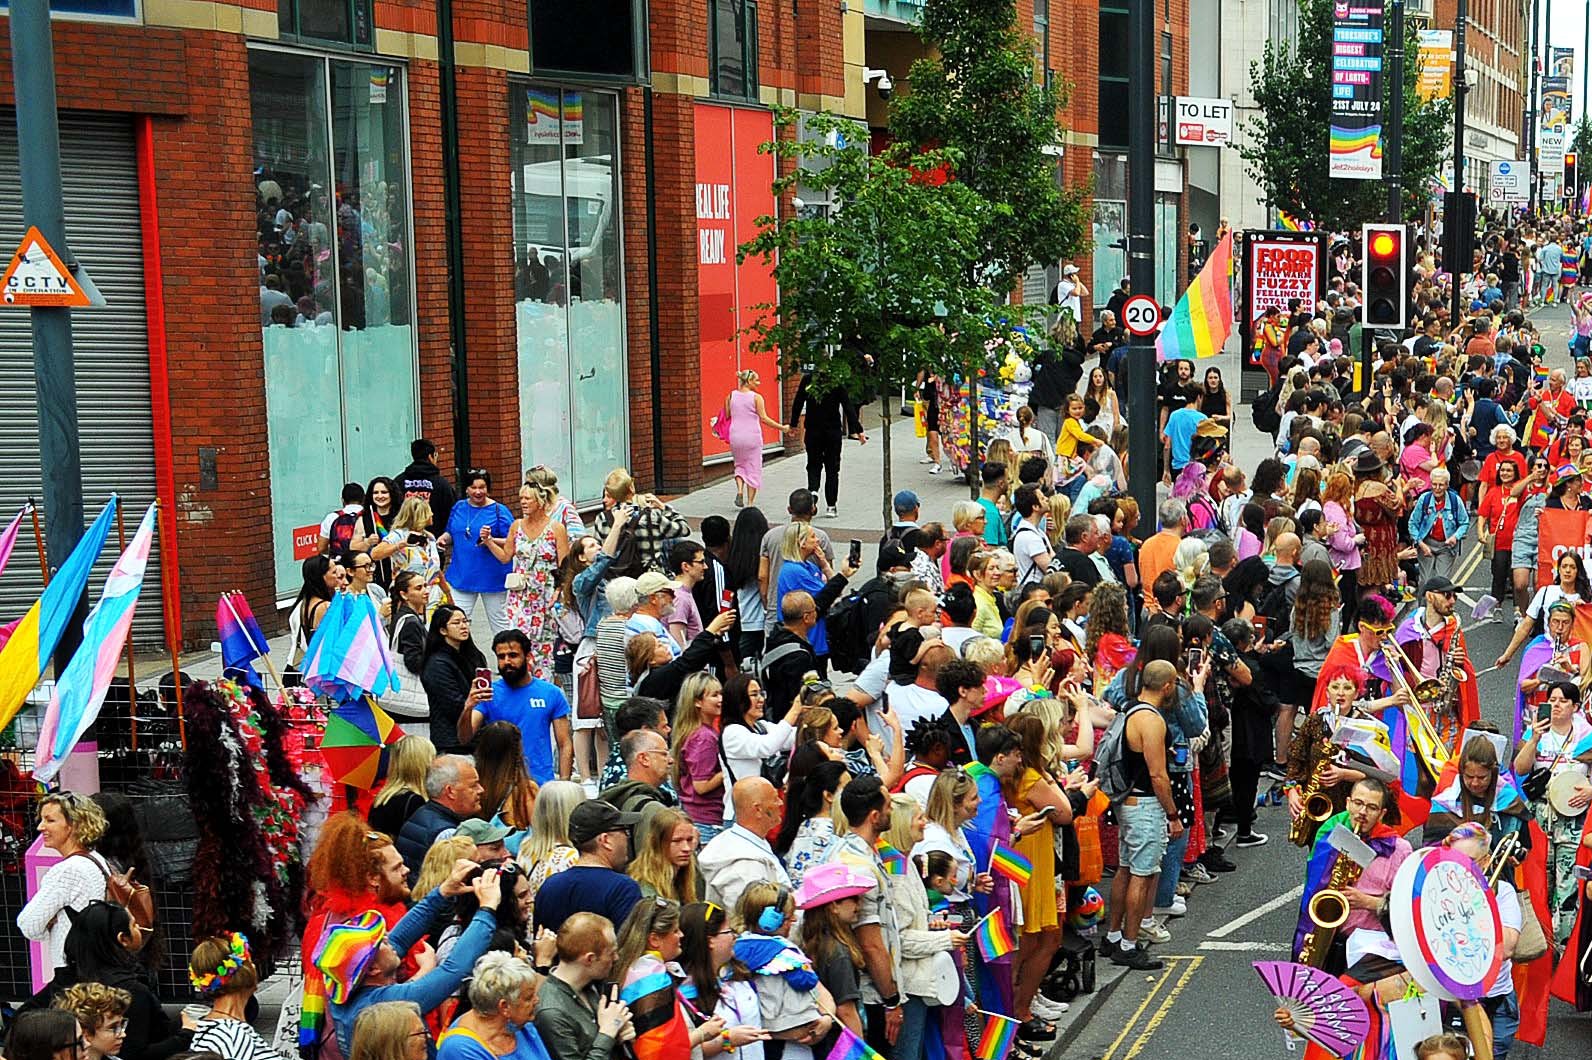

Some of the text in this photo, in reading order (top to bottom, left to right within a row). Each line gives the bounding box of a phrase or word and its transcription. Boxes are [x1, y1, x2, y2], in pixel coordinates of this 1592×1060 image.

[1179, 103, 1230, 119] TO LET
[1333, 100, 1350, 110] 21ST
[1351, 101, 1369, 110] JULY
[1542, 137, 1562, 145] NEW
[713, 184, 730, 219] LIFE
[1257, 248, 1313, 263] FOOD
[8, 276, 68, 288] CCTV
[1257, 278, 1311, 290] FUZZY
[1257, 290, 1312, 299] FEELING OF
[1257, 298, 1286, 306] TOTAL
[1128, 307, 1155, 323] 20
[296, 536, 312, 547] CLICK
